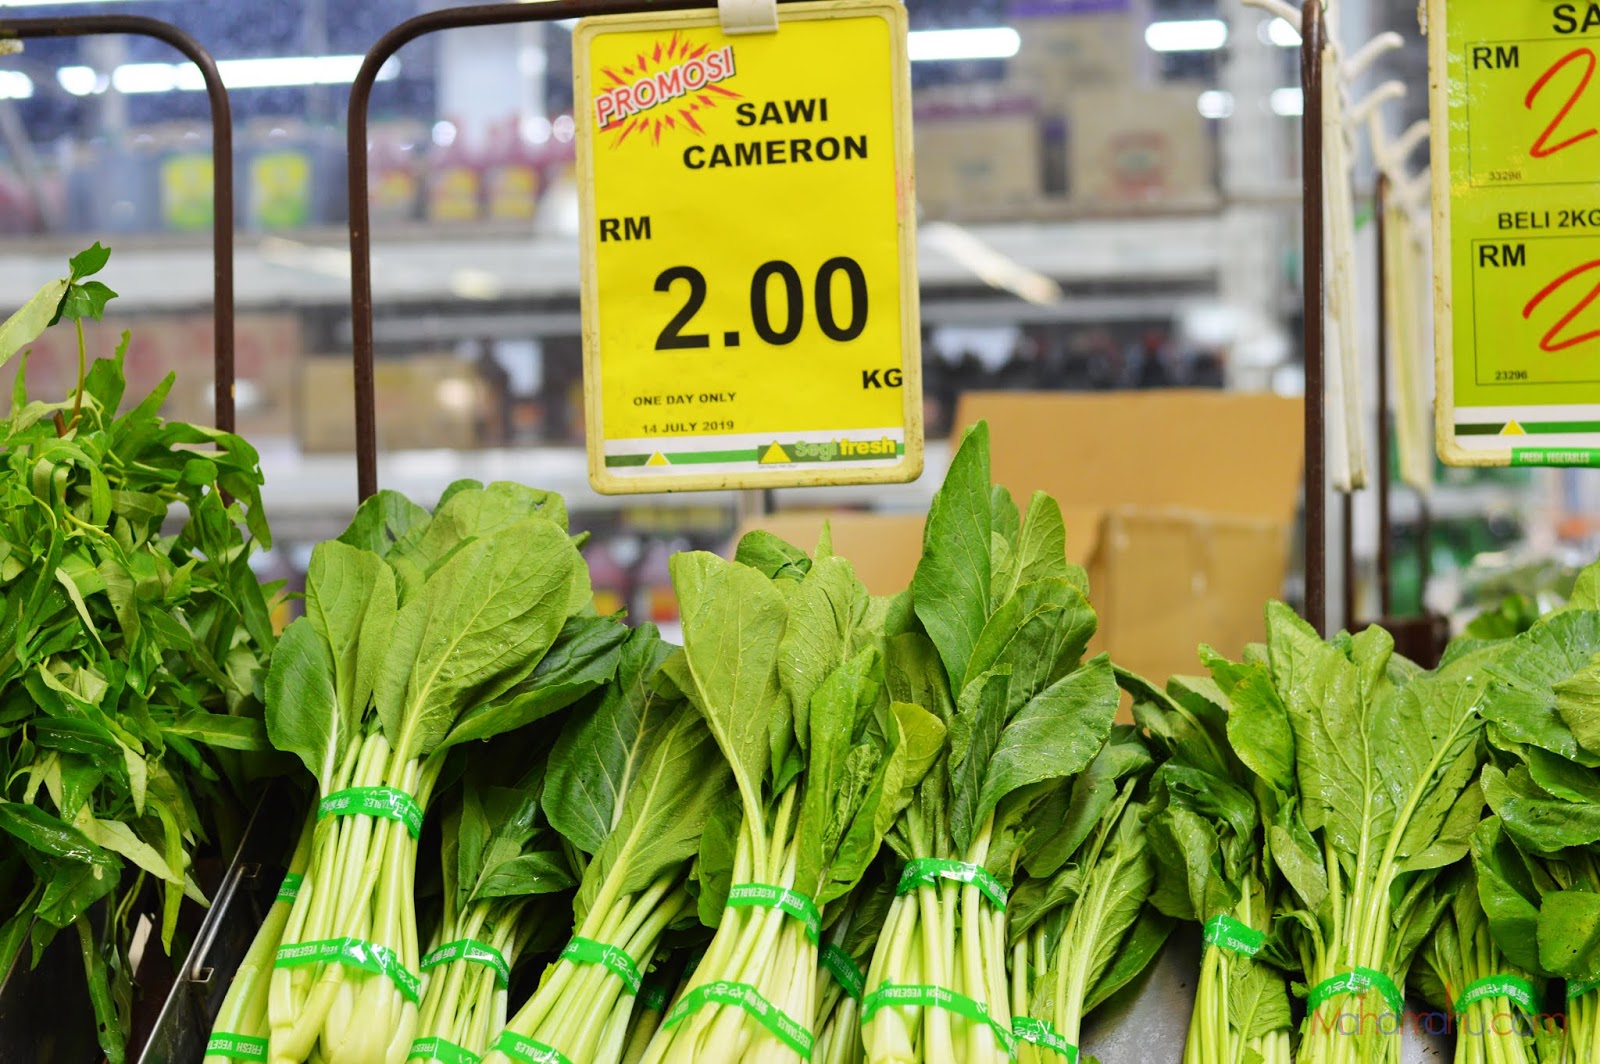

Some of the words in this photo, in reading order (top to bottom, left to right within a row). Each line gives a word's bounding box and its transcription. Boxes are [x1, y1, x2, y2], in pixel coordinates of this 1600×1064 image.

[1472, 46, 1519, 70] RM
[595, 46, 736, 127] PROMOSI
[735, 98, 828, 127] SAWI
[683, 136, 868, 170] CAMERON
[599, 216, 652, 242] RM
[1498, 211, 1549, 229] BELI
[1479, 244, 1525, 267] RM
[653, 256, 869, 350] 2.00
[862, 368, 903, 389] KG
[633, 396, 662, 406] ONE
[666, 394, 694, 405] DAY
[699, 392, 736, 403] ONLY
[643, 424, 657, 434] 14
[661, 422, 697, 433] JULY
[702, 420, 734, 431] 2019
